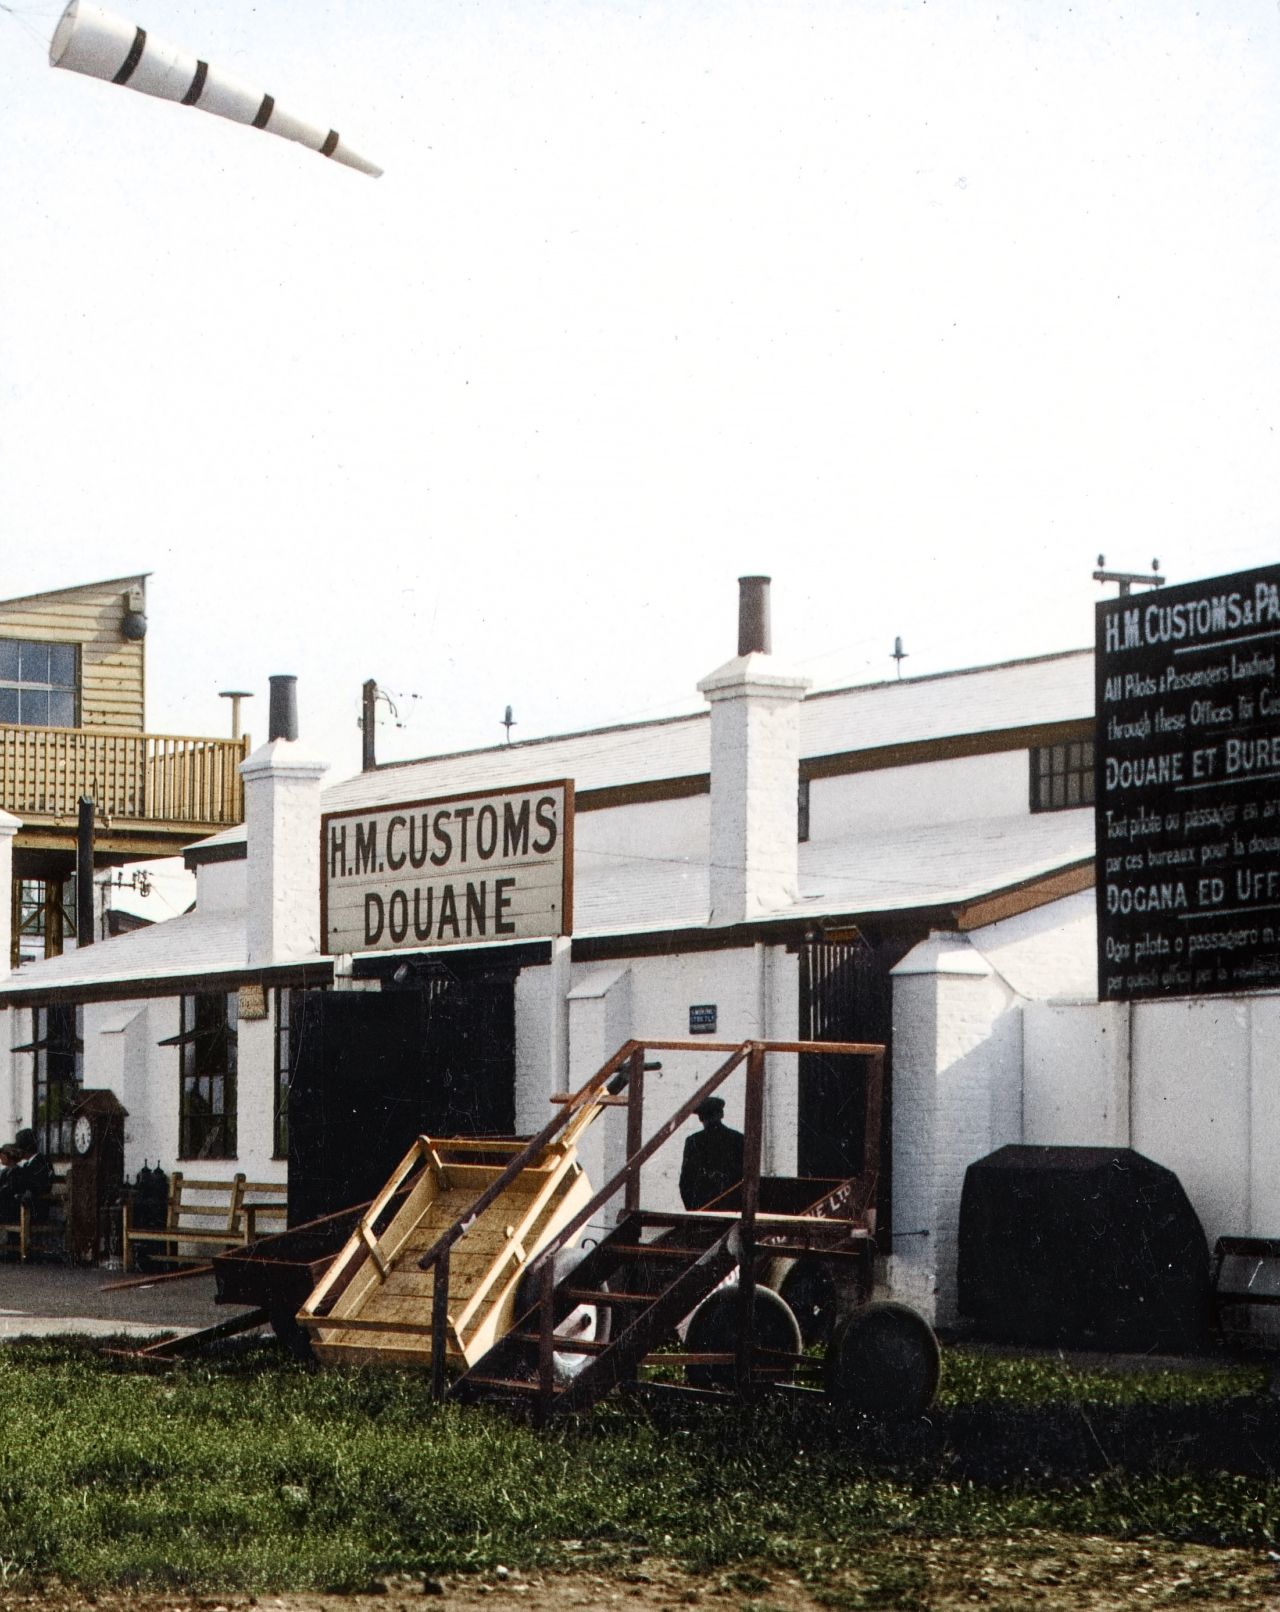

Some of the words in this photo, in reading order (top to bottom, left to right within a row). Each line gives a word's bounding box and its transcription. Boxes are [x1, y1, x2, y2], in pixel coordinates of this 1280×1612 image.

[1104, 675, 1122, 702] All
[1125, 672, 1157, 699] Pilots
[1166, 665, 1230, 690] Passengers
[1231, 652, 1276, 680] Landing
[1108, 711, 1152, 741] through
[1155, 707, 1186, 733] these
[1190, 700, 1234, 726] Offices
[1106, 752, 1184, 791] DOUANE
[1192, 748, 1218, 778] ET
[1125, 854, 1144, 870] ces
[1148, 847, 1196, 867] bureaux
[364, 878, 516, 946] DOUANE
[1107, 882, 1188, 914] DOGANA
[1199, 878, 1224, 906] ED
